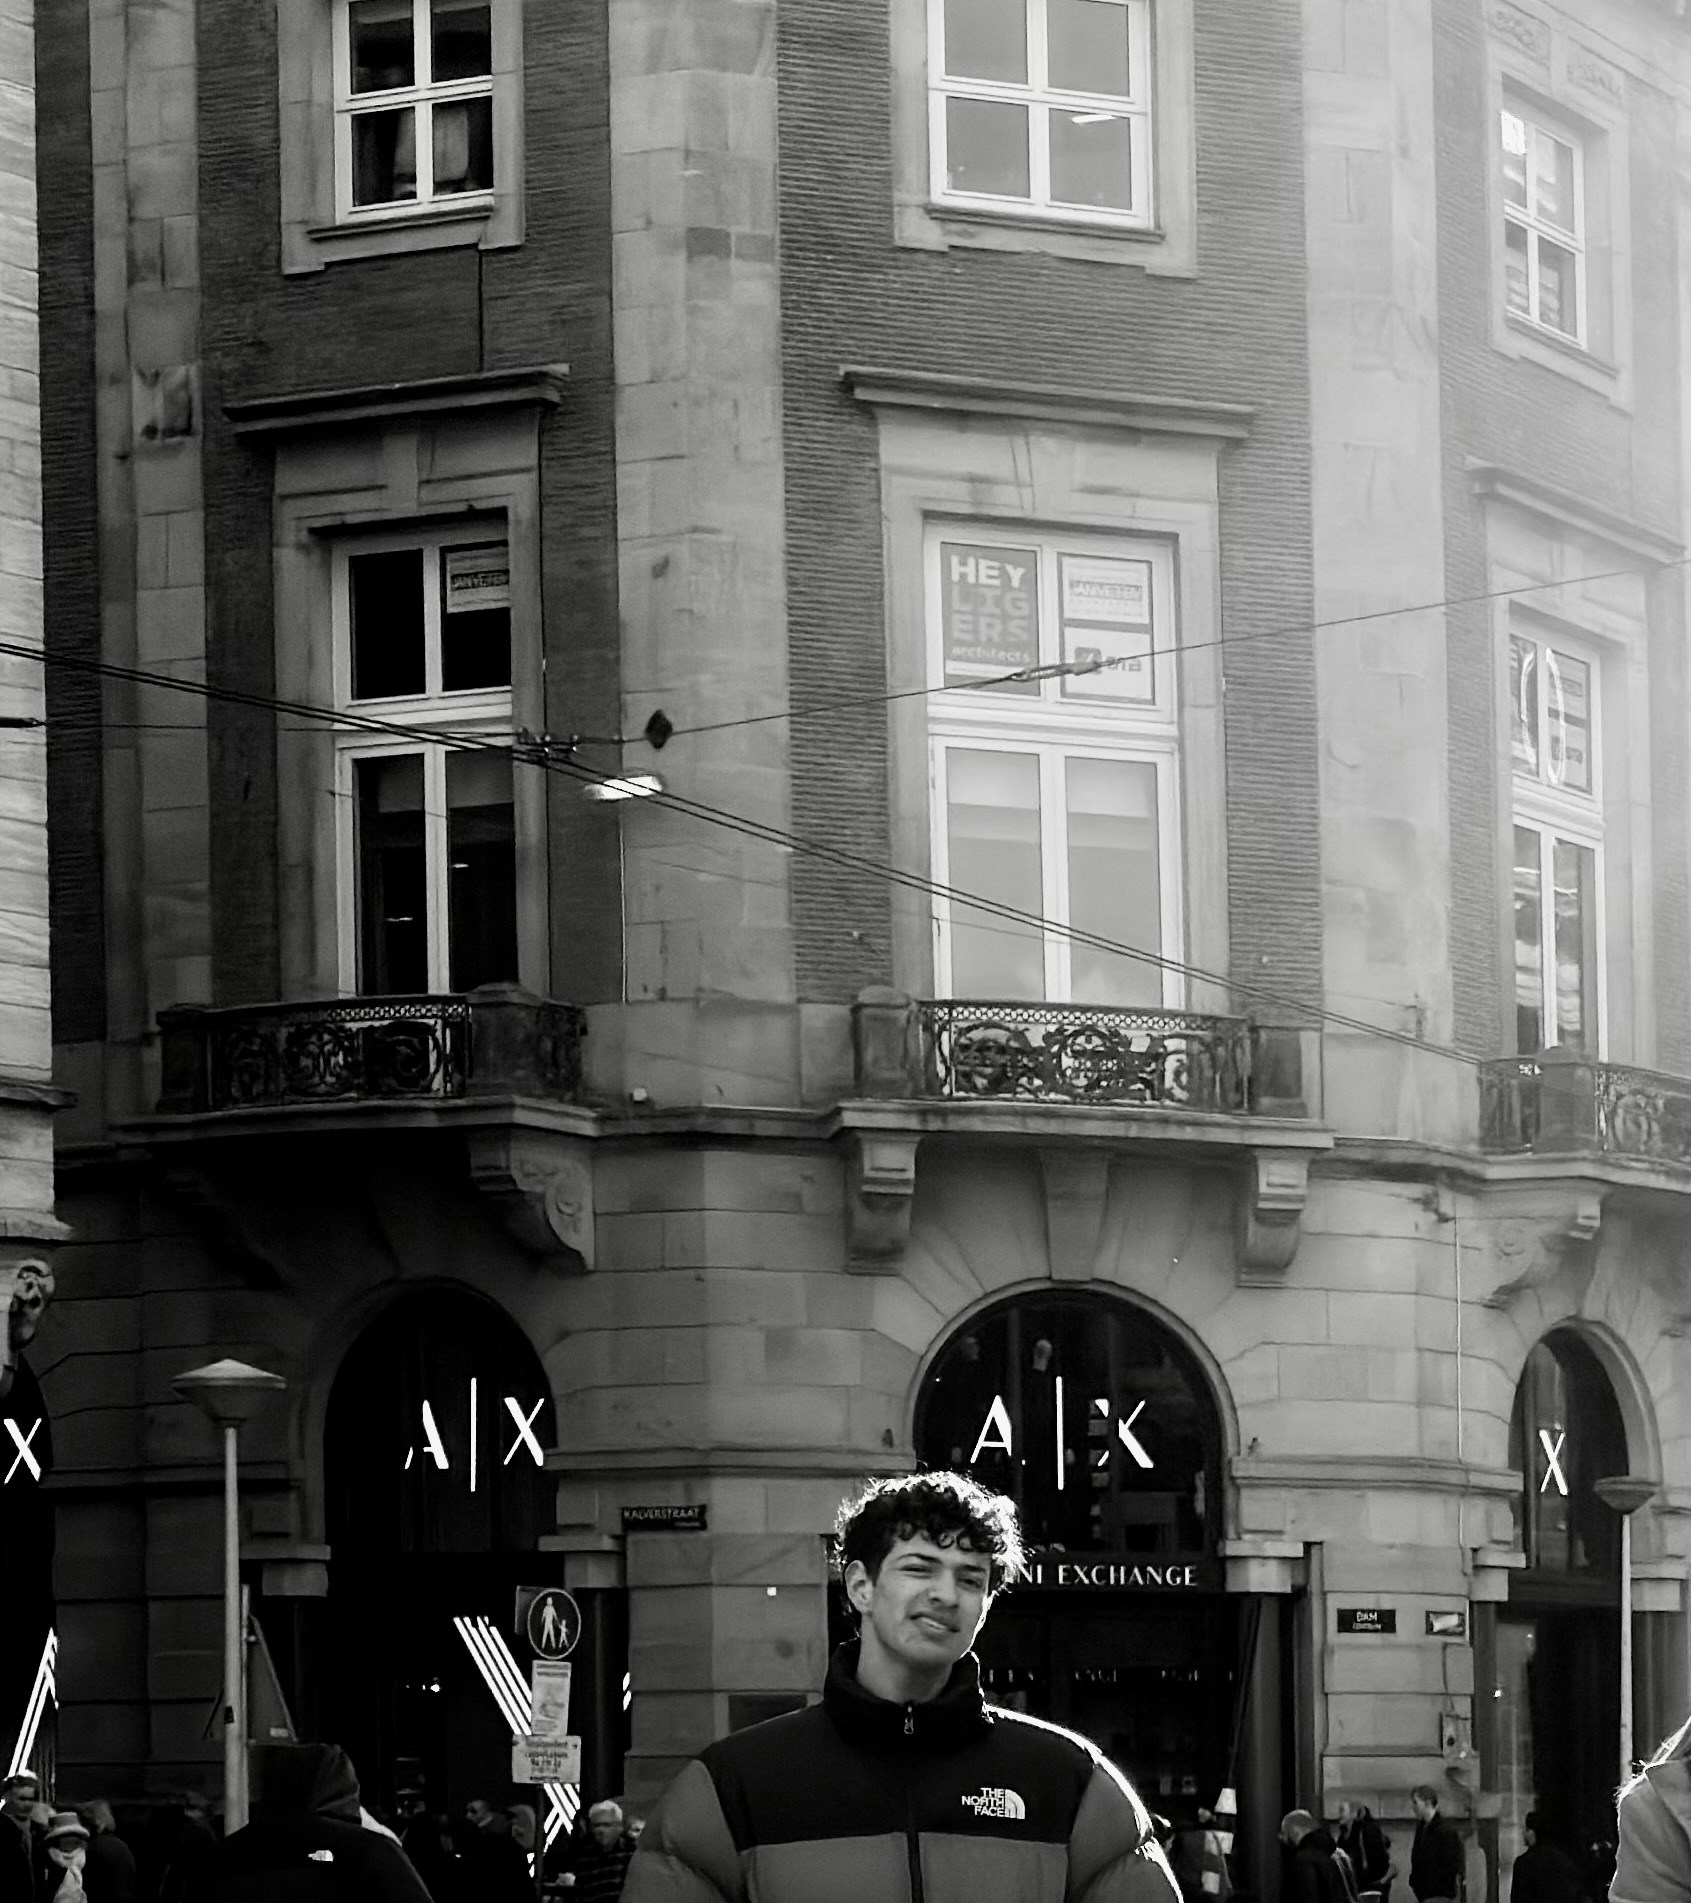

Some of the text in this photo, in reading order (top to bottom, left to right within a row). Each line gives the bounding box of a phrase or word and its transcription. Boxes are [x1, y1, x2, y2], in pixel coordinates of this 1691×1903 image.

[950, 555, 1026, 588] HEY
[952, 585, 1029, 617] LIG
[952, 613, 1029, 642] ERS
[1539, 1430, 1568, 1496] X
[1058, 1564, 1199, 1587] EXCHANGE
[961, 1795, 1005, 1810] NORTH
[980, 1787, 1005, 1798] THE
[975, 1805, 1006, 1817] FACE
